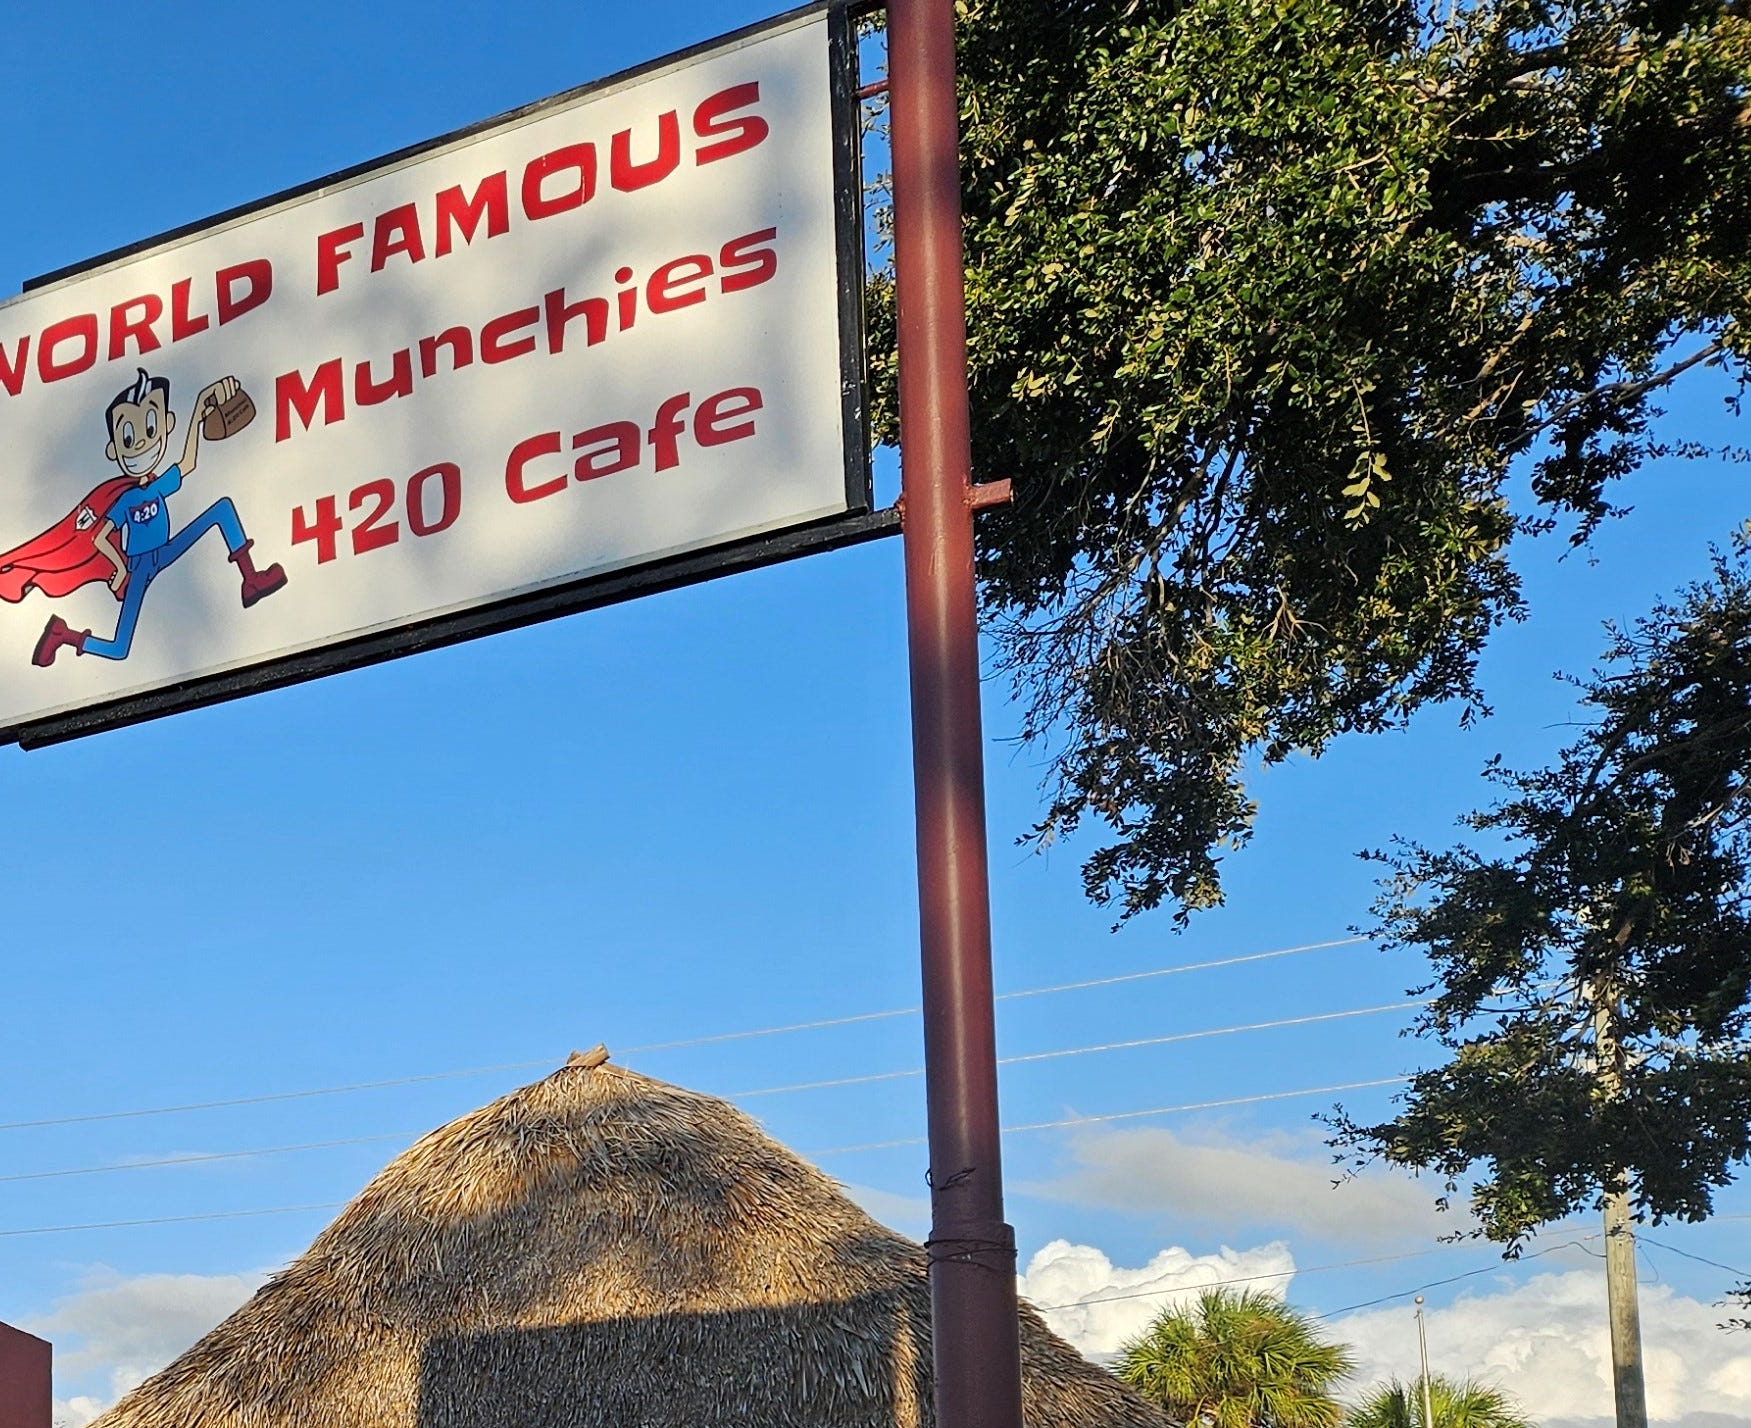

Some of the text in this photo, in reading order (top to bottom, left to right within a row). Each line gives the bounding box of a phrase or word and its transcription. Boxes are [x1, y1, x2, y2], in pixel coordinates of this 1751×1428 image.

[315, 81, 770, 295] FAMOUS
[275, 226, 779, 443] Munchies
[133, 503, 159, 523] 4:20
[290, 386, 764, 565] 420 Cafe
